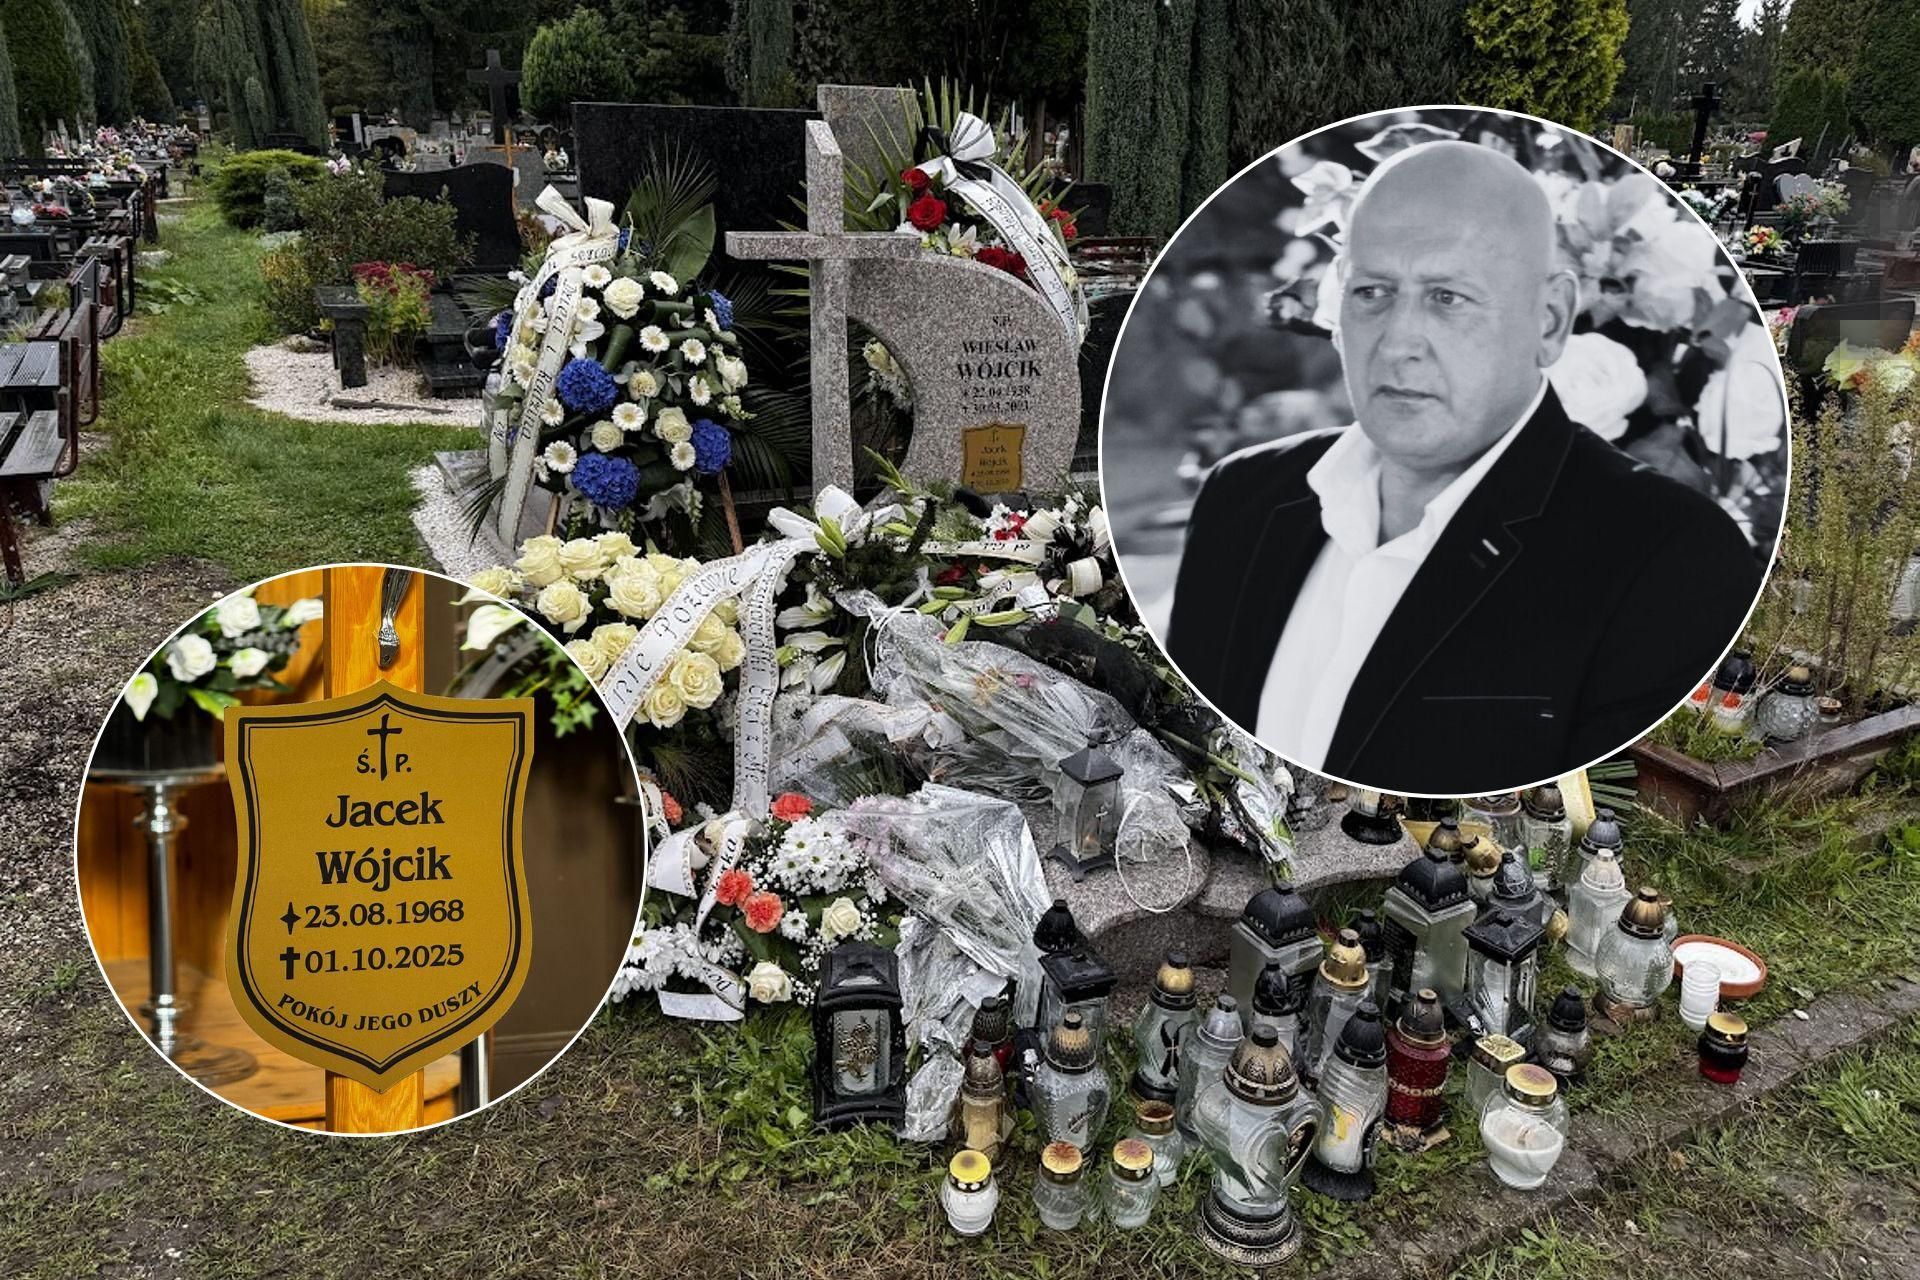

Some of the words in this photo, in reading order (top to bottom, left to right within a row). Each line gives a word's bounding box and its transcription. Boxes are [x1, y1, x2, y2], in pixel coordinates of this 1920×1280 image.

[957, 356, 1042, 380] WÓJCIK
[325, 792, 445, 828] Jacek
[315, 846, 453, 891] Wójcik
[304, 900, 464, 929] 23.08.1968
[304, 943, 464, 973] 01.10.2025
[277, 992, 348, 1029] POKÓJ
[353, 1013, 412, 1031] JEGO
[419, 981, 483, 1022] DUSZY
